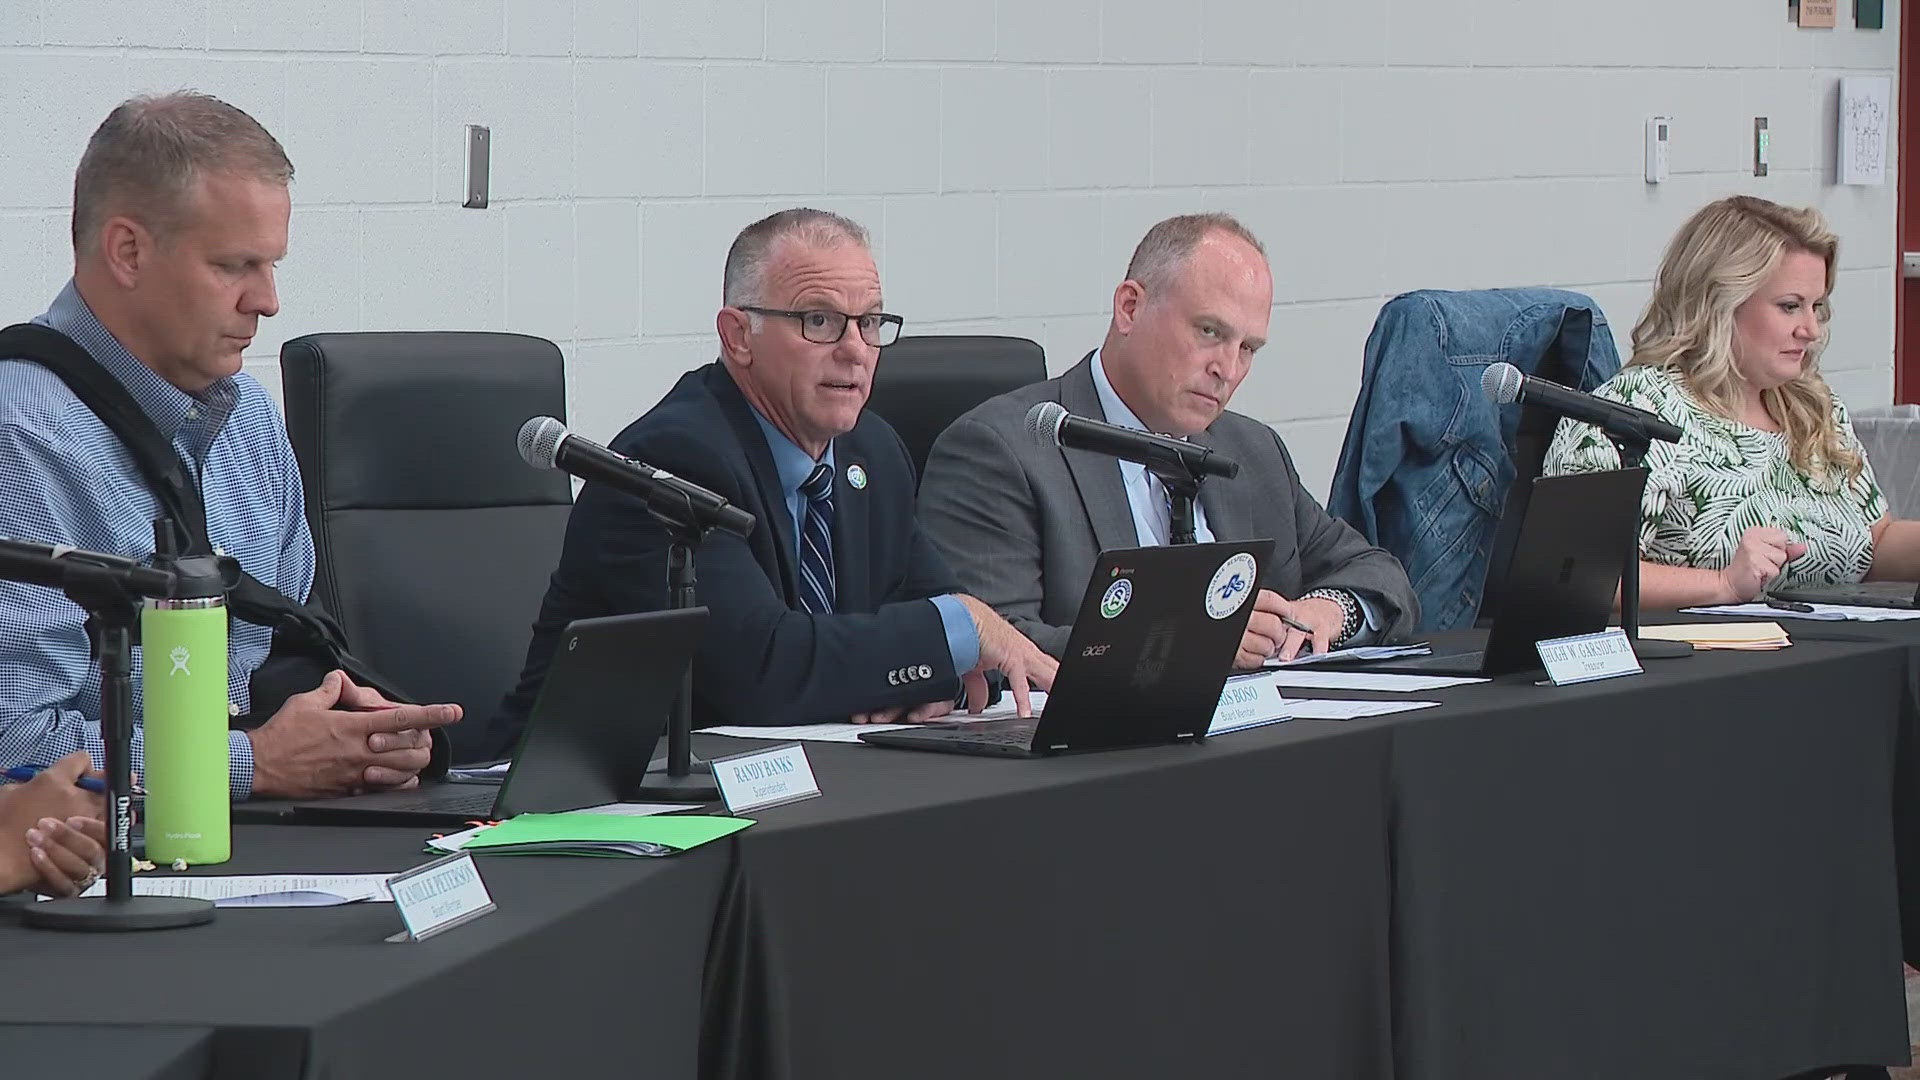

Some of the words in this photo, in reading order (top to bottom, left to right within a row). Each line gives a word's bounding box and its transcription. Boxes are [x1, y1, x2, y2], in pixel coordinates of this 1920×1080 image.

[1082, 644, 1111, 656] acer
[1543, 645, 1569, 664] HUGH
[1566, 644, 1580, 660] W.
[1233, 686, 1258, 704] BOSO
[1221, 709, 1235, 721] Board
[1236, 707, 1256, 719] Member
[733, 761, 765, 784] RANDY
[763, 755, 794, 777] BANKS
[117, 796, 131, 852] On-Stage
